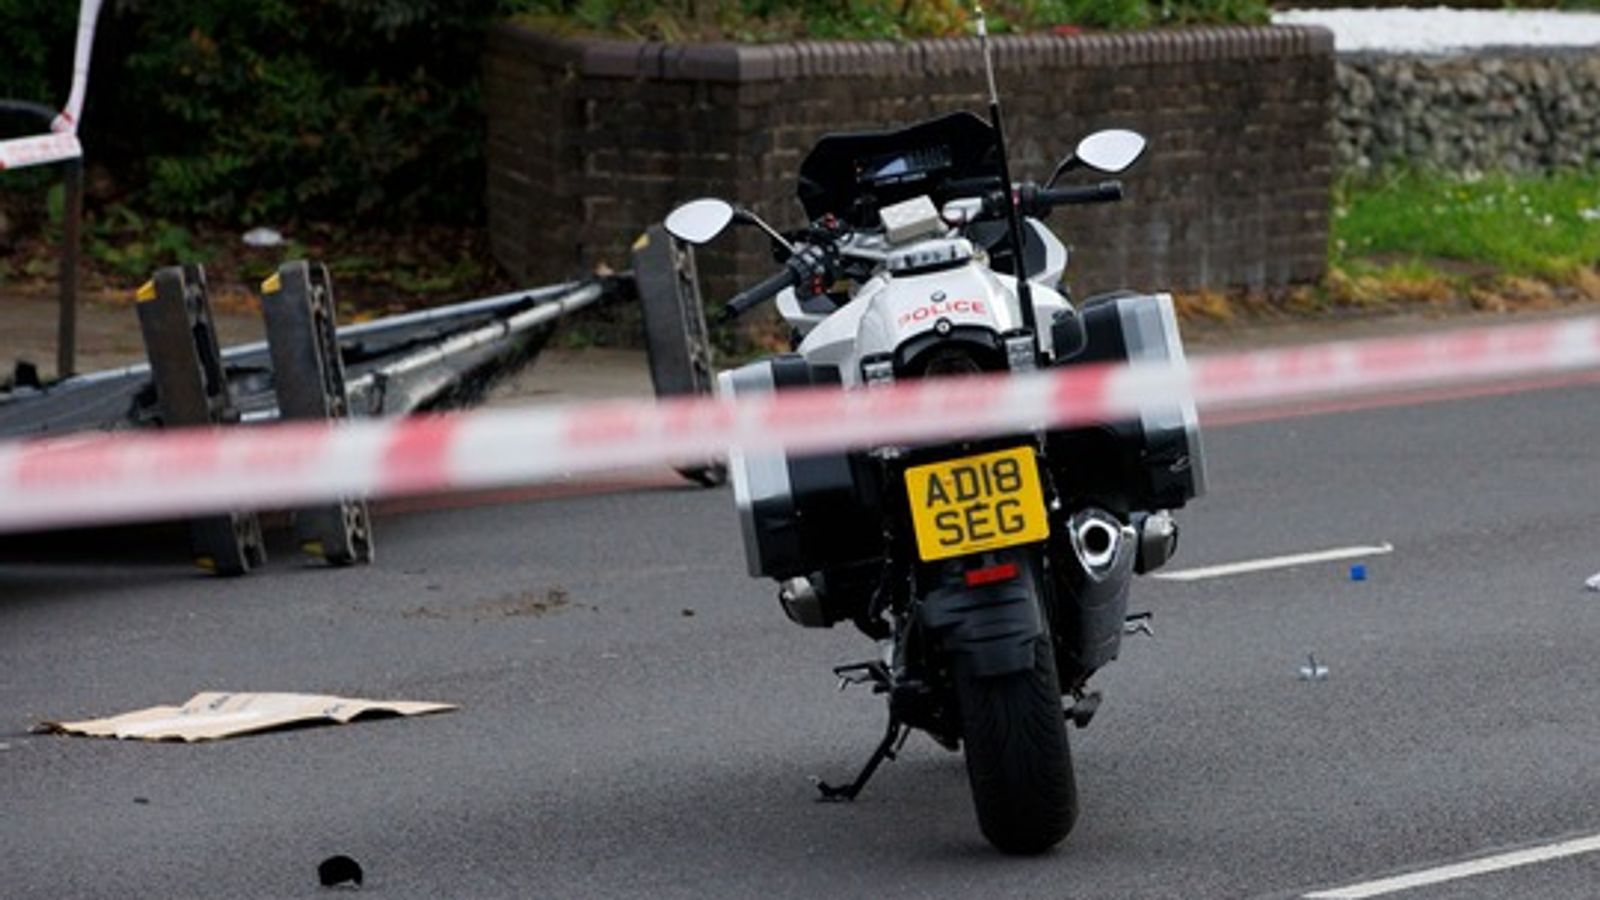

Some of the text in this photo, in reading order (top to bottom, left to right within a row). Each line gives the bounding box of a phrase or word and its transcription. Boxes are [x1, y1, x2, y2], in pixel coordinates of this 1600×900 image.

[898, 300, 986, 327] POLICE
[926, 457, 1022, 508] AD18
[935, 499, 1024, 546] SEG
